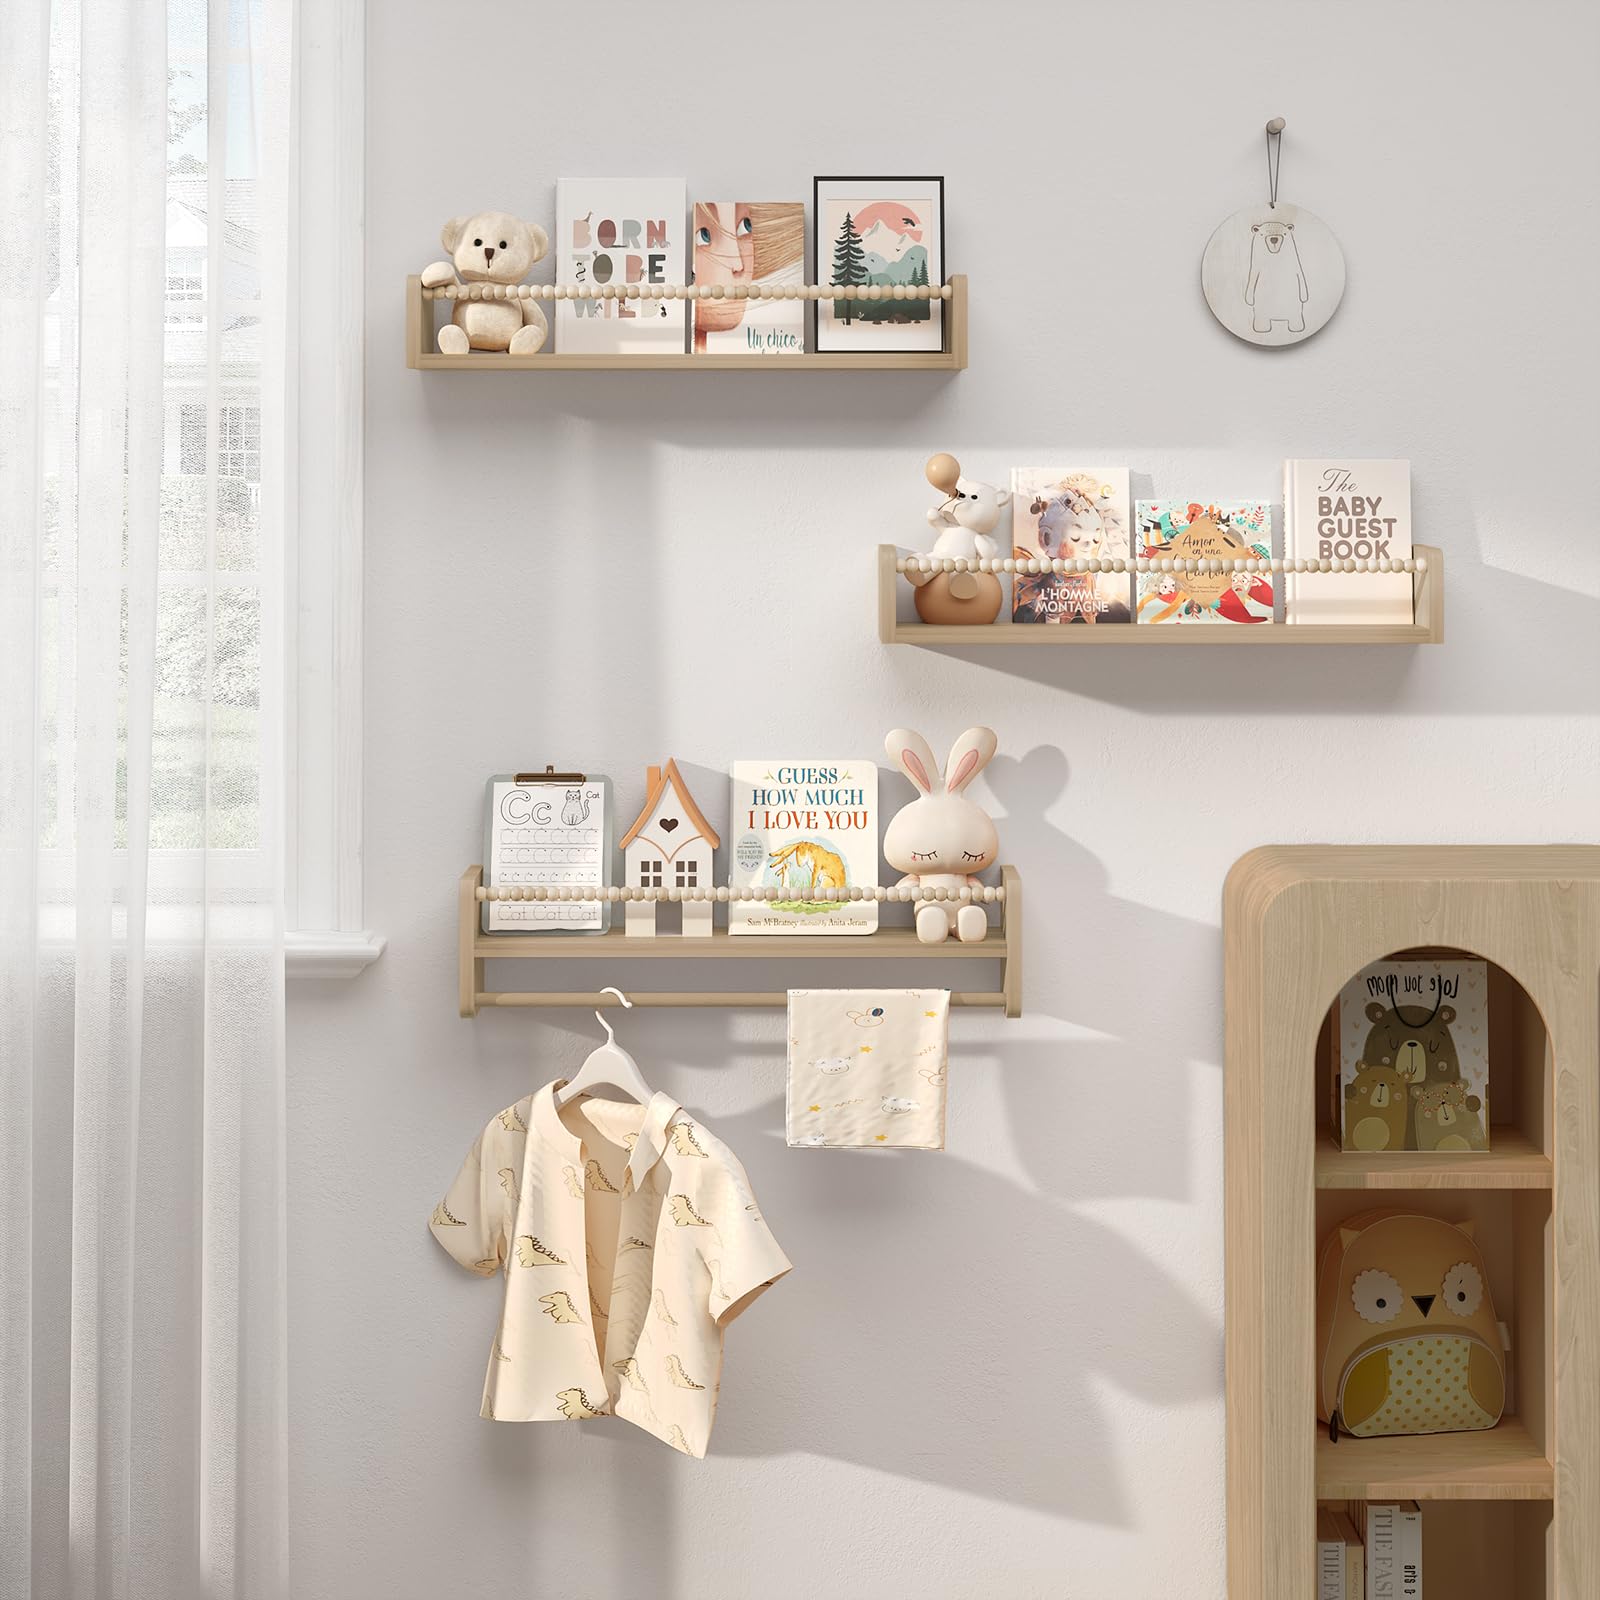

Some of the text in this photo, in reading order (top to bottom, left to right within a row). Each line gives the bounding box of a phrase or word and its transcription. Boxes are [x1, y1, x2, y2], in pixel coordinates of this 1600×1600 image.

[573, 219, 668, 249] BORN
[572, 253, 667, 284] TO BE
[747, 326, 763, 349] Un
[767, 328, 798, 348] chico
[1318, 468, 1358, 492] The
[1318, 496, 1382, 516] BABY
[1317, 518, 1397, 539] GUEST
[1182, 534, 1215, 549] Amor
[1319, 540, 1391, 560] BOOK
[1041, 587, 1102, 601] L'HOMME
[1035, 601, 1109, 613] MONTAGNE
[778, 767, 838, 784] GUESS
[586, 791, 600, 799] Cat
[752, 788, 864, 806] HOW MUCH
[748, 810, 868, 830] I LOVE YOU
[748, 918, 761, 926] Sam
[828, 918, 846, 926] Anita
[847, 918, 868, 926] Jeram
[1375, 1509, 1393, 1551] THE
[1323, 1544, 1339, 1579] THE
[1404, 1564, 1418, 1584] arts
